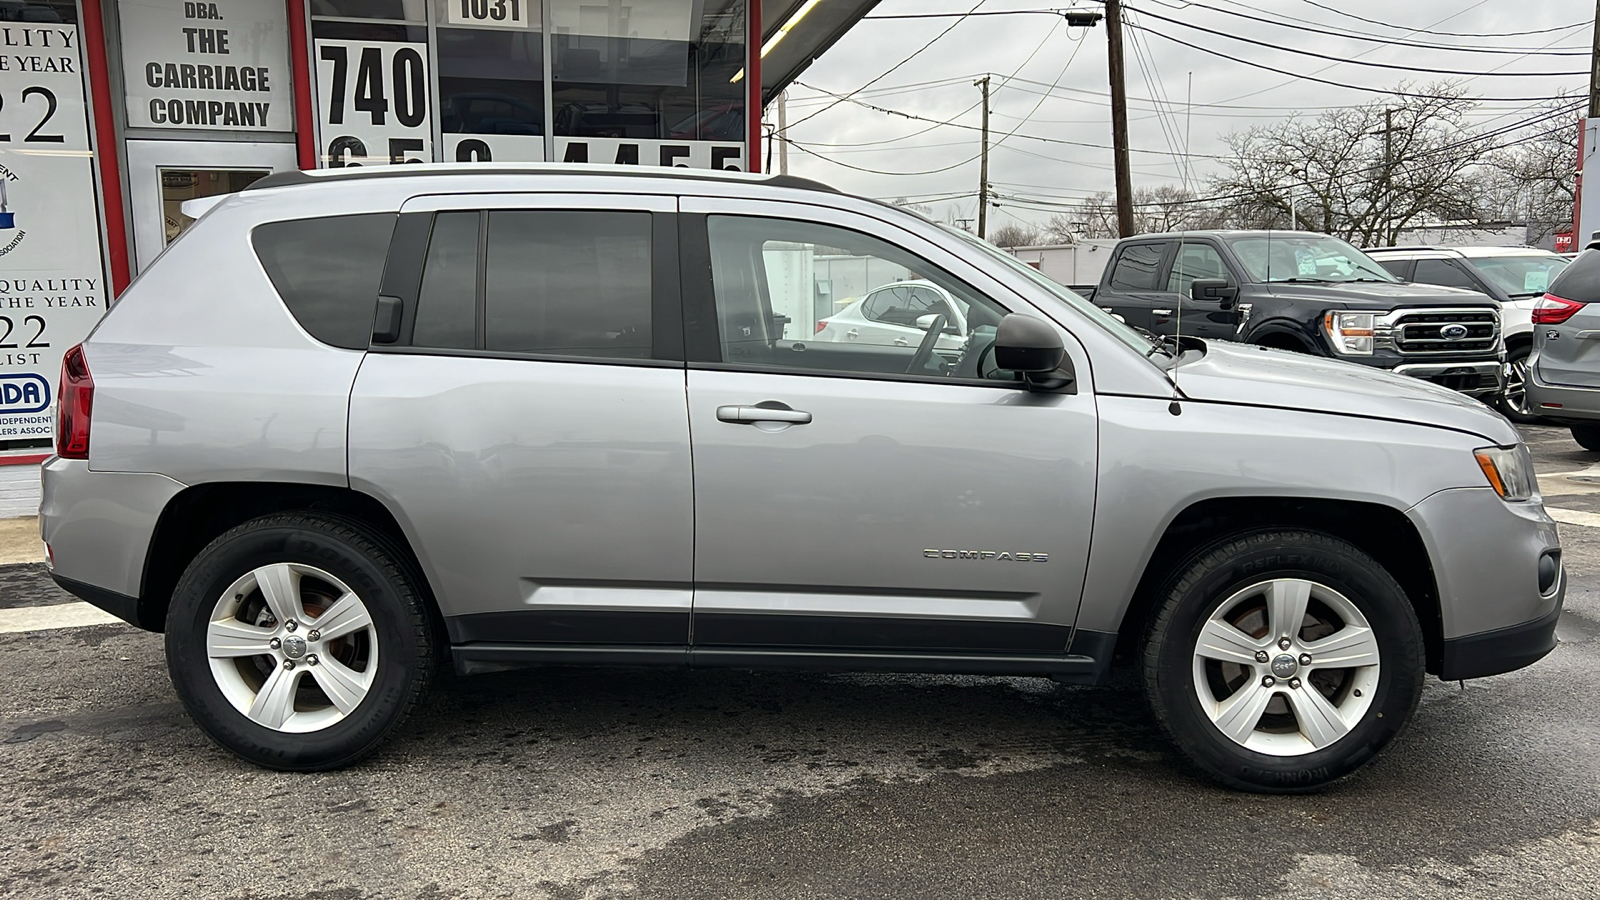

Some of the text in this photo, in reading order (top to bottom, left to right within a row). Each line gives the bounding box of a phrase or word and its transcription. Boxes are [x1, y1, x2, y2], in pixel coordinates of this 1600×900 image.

[184, 2, 224, 20] DBA.
[2, 28, 74, 48] LITY
[182, 27, 230, 54] THE
[14, 55, 75, 73] YEAR
[145, 62, 271, 92] CARRIAGE
[320, 45, 426, 128] 740
[149, 98, 270, 127] COMPANY
[0, 278, 97, 294] QUALITY
[44, 296, 97, 308] YEAR
[923, 548, 1049, 563] COMPASS
